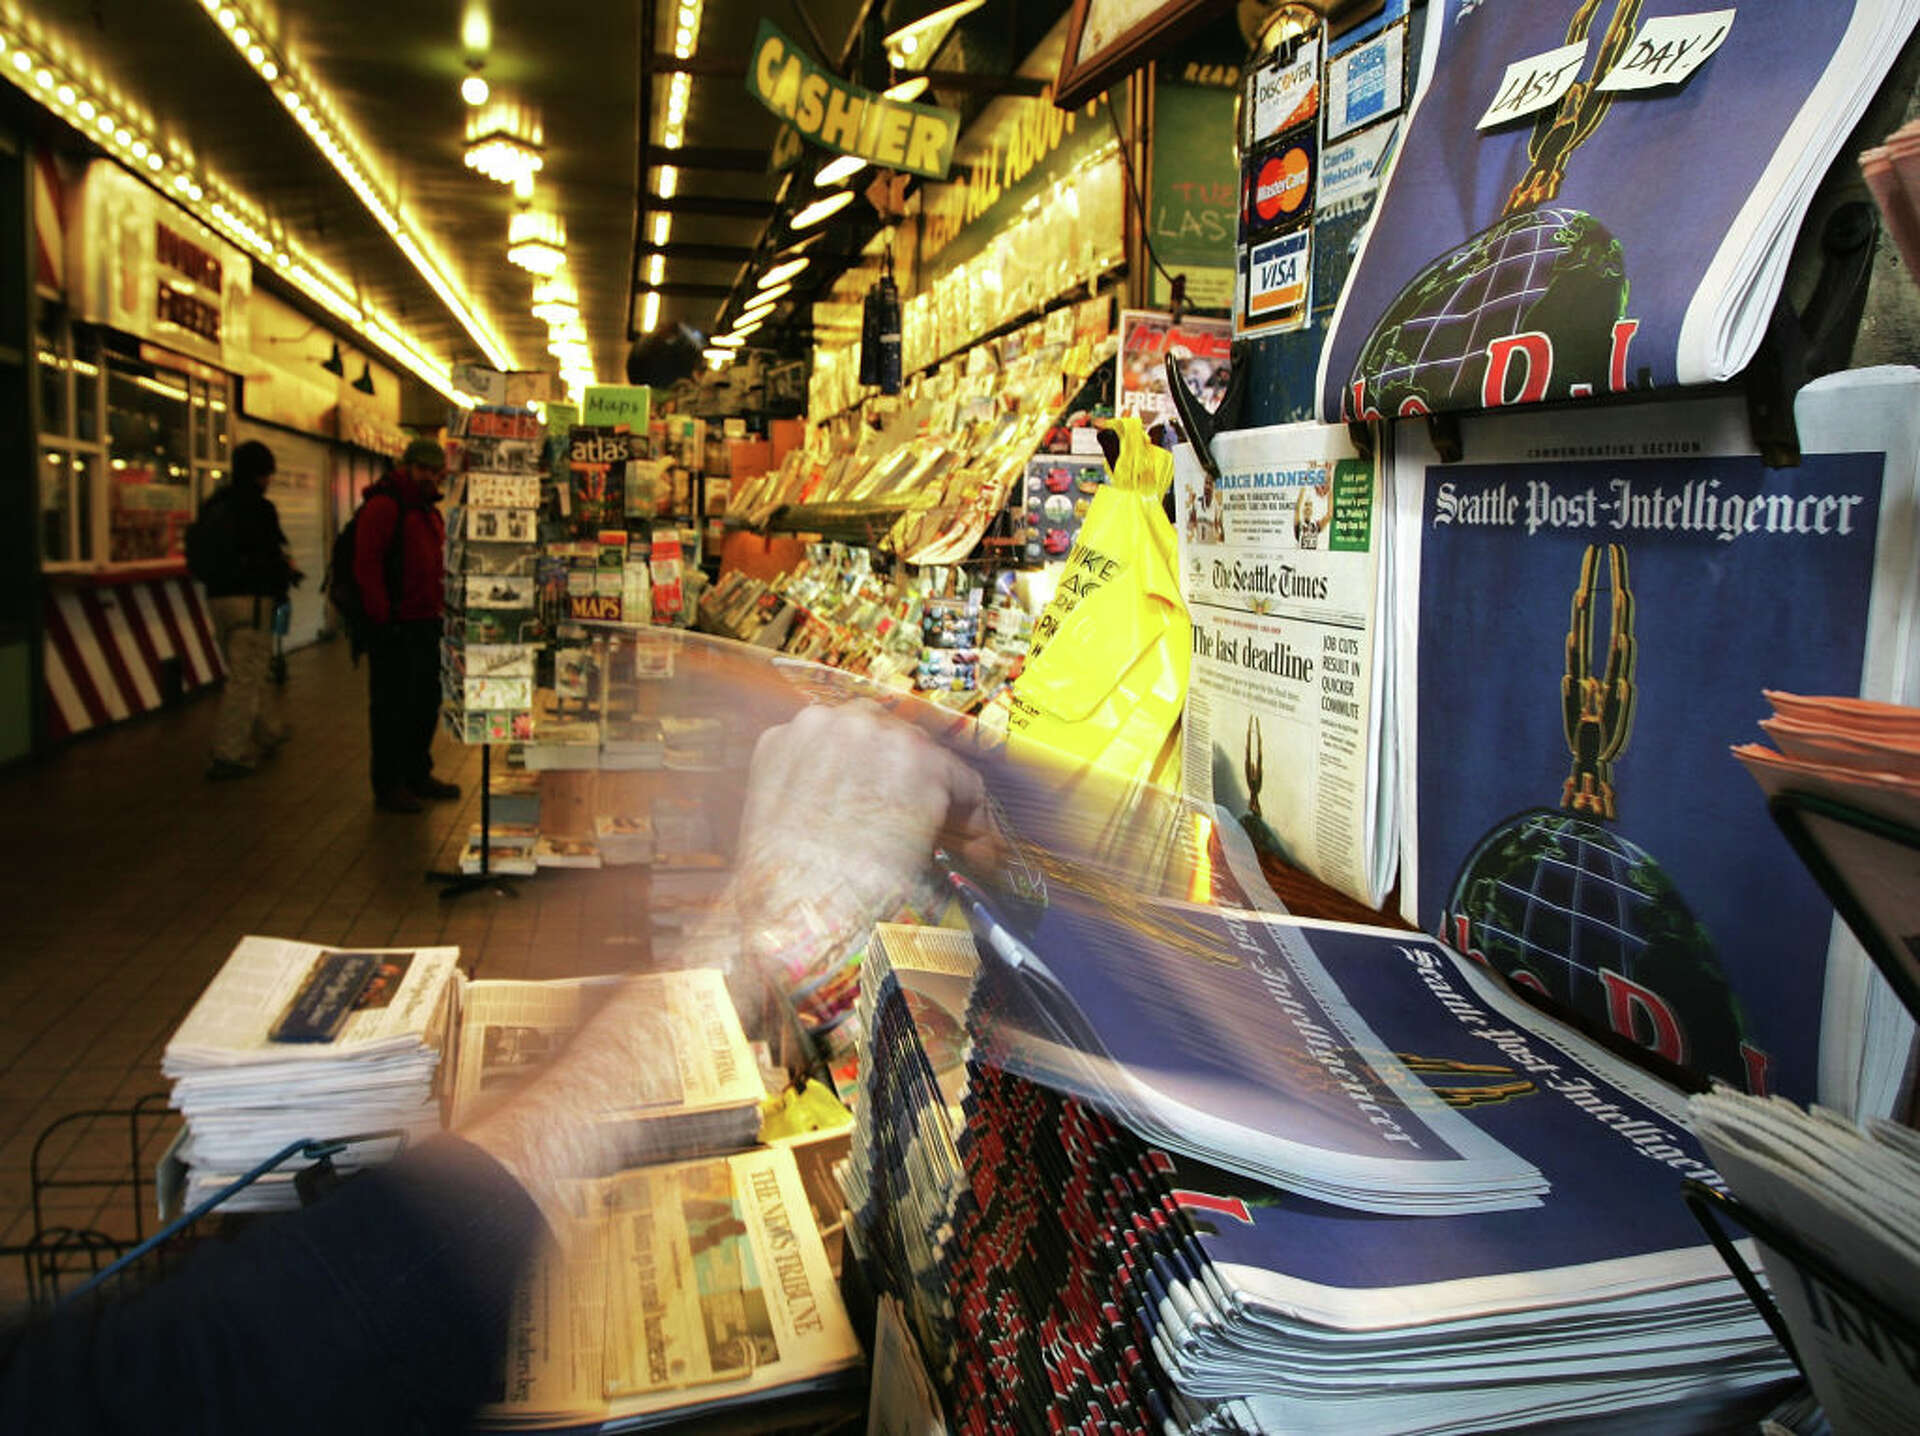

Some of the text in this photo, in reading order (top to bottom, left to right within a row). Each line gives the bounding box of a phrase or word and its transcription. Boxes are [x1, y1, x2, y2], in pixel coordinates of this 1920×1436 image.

[1259, 61, 1313, 103] DISCOVER
[1491, 26, 1726, 113] LAST DAY!
[755, 36, 949, 175] CASHIER
[1323, 145, 1355, 170] Cards
[1257, 169, 1308, 203] MasterCard
[1323, 159, 1374, 188] Welcome
[1260, 256, 1297, 290] VISA
[588, 395, 639, 416] Maps
[571, 435, 630, 463] atlas
[1252, 468, 1327, 490] MADNESS
[1433, 481, 1519, 530] Seattle
[1525, 477, 1865, 542] Post-Intelligencer
[1212, 559, 1328, 600] The Seattle Times
[571, 597, 620, 620] MAPS
[1190, 623, 1214, 658] The
[1215, 630, 1239, 666] last
[1242, 636, 1314, 683] deadline
[1323, 634, 1359, 656] JOB CUTS
[1321, 655, 1361, 678] RESULT IN
[1321, 676, 1355, 697] QUICKER
[1321, 696, 1360, 721] COMMUTE
[1392, 944, 1488, 1026] Seattle
[1470, 1027, 1742, 1205] Post-Intelligen
[750, 1168, 824, 1337] THE NEWS TRIBUNE
